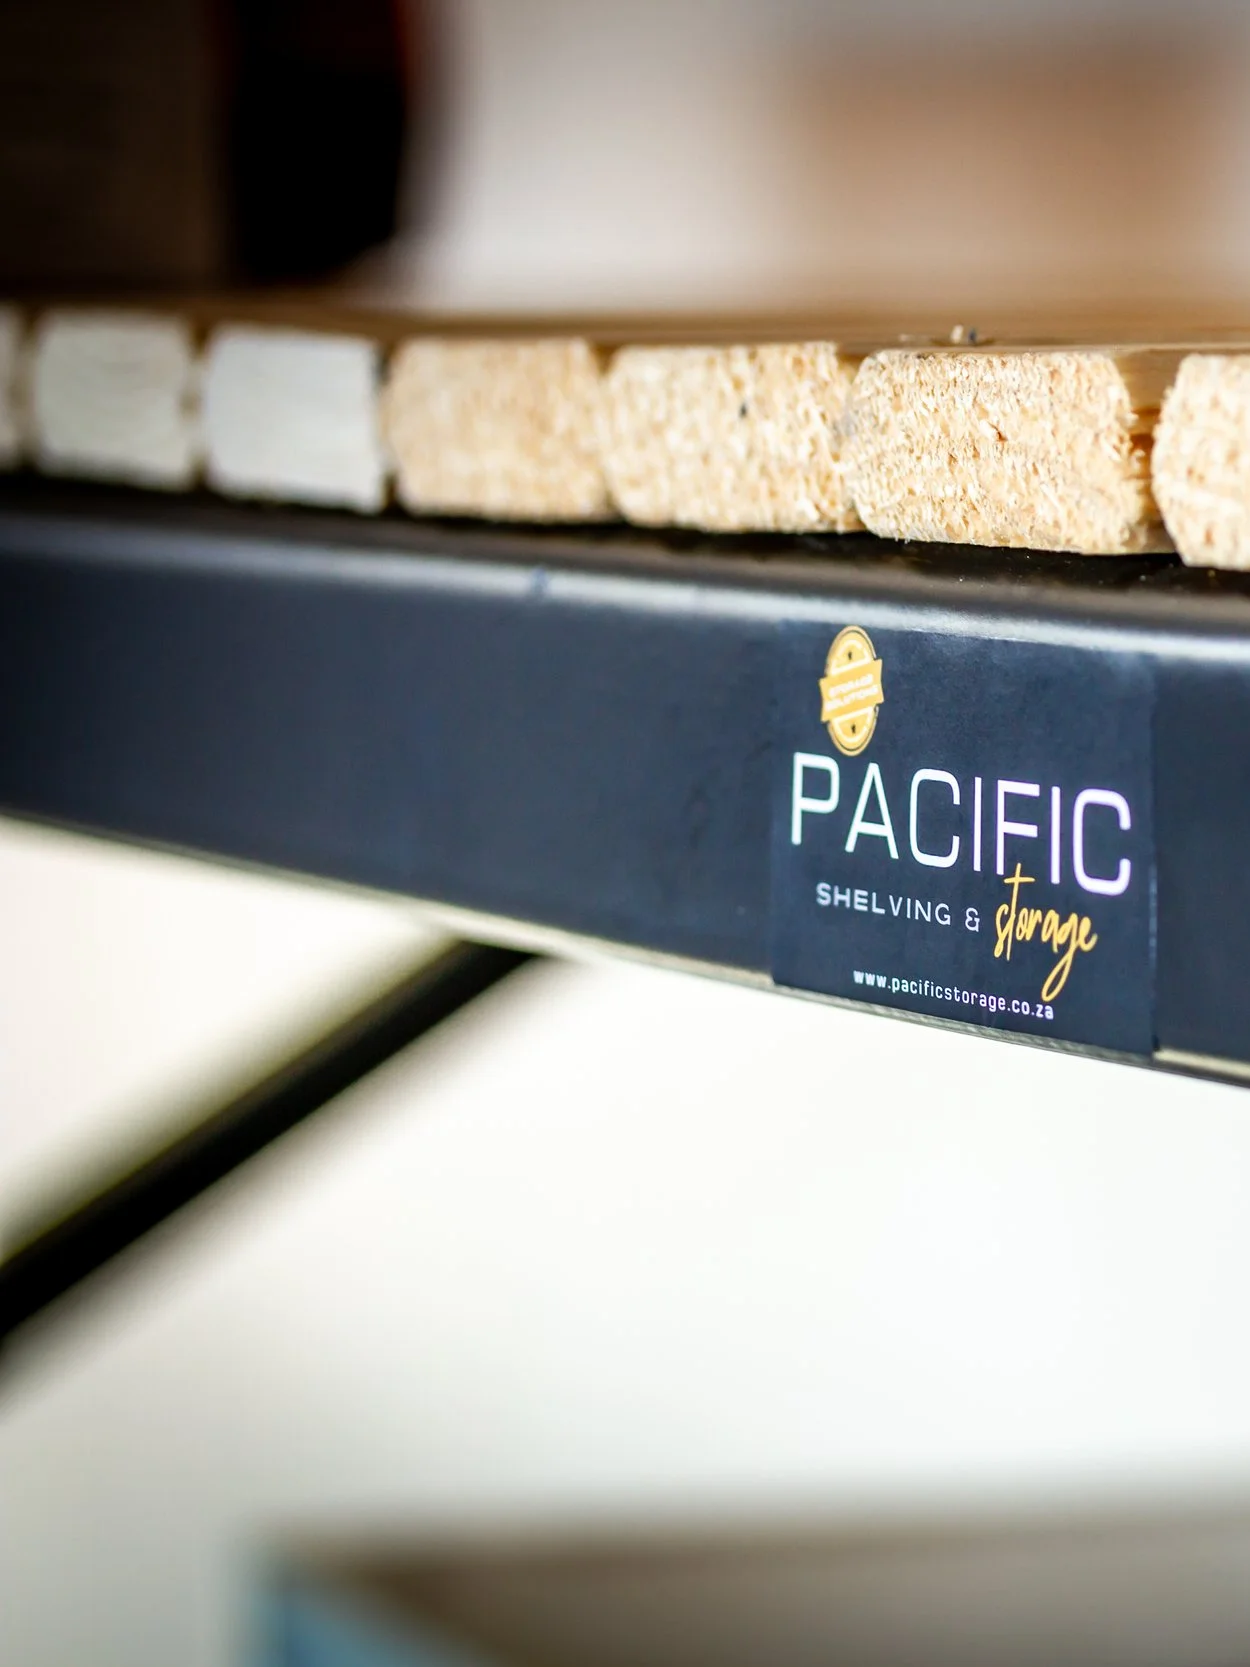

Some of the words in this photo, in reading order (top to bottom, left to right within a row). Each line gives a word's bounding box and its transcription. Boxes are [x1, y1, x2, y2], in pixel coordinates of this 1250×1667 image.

[790, 752, 1132, 896] PACIFIC
[815, 882, 952, 926] SHELVING
[964, 907, 980, 932] &
[994, 862, 1098, 1002] storage
[853, 970, 1055, 1020] www.pacificstorage.co.za
